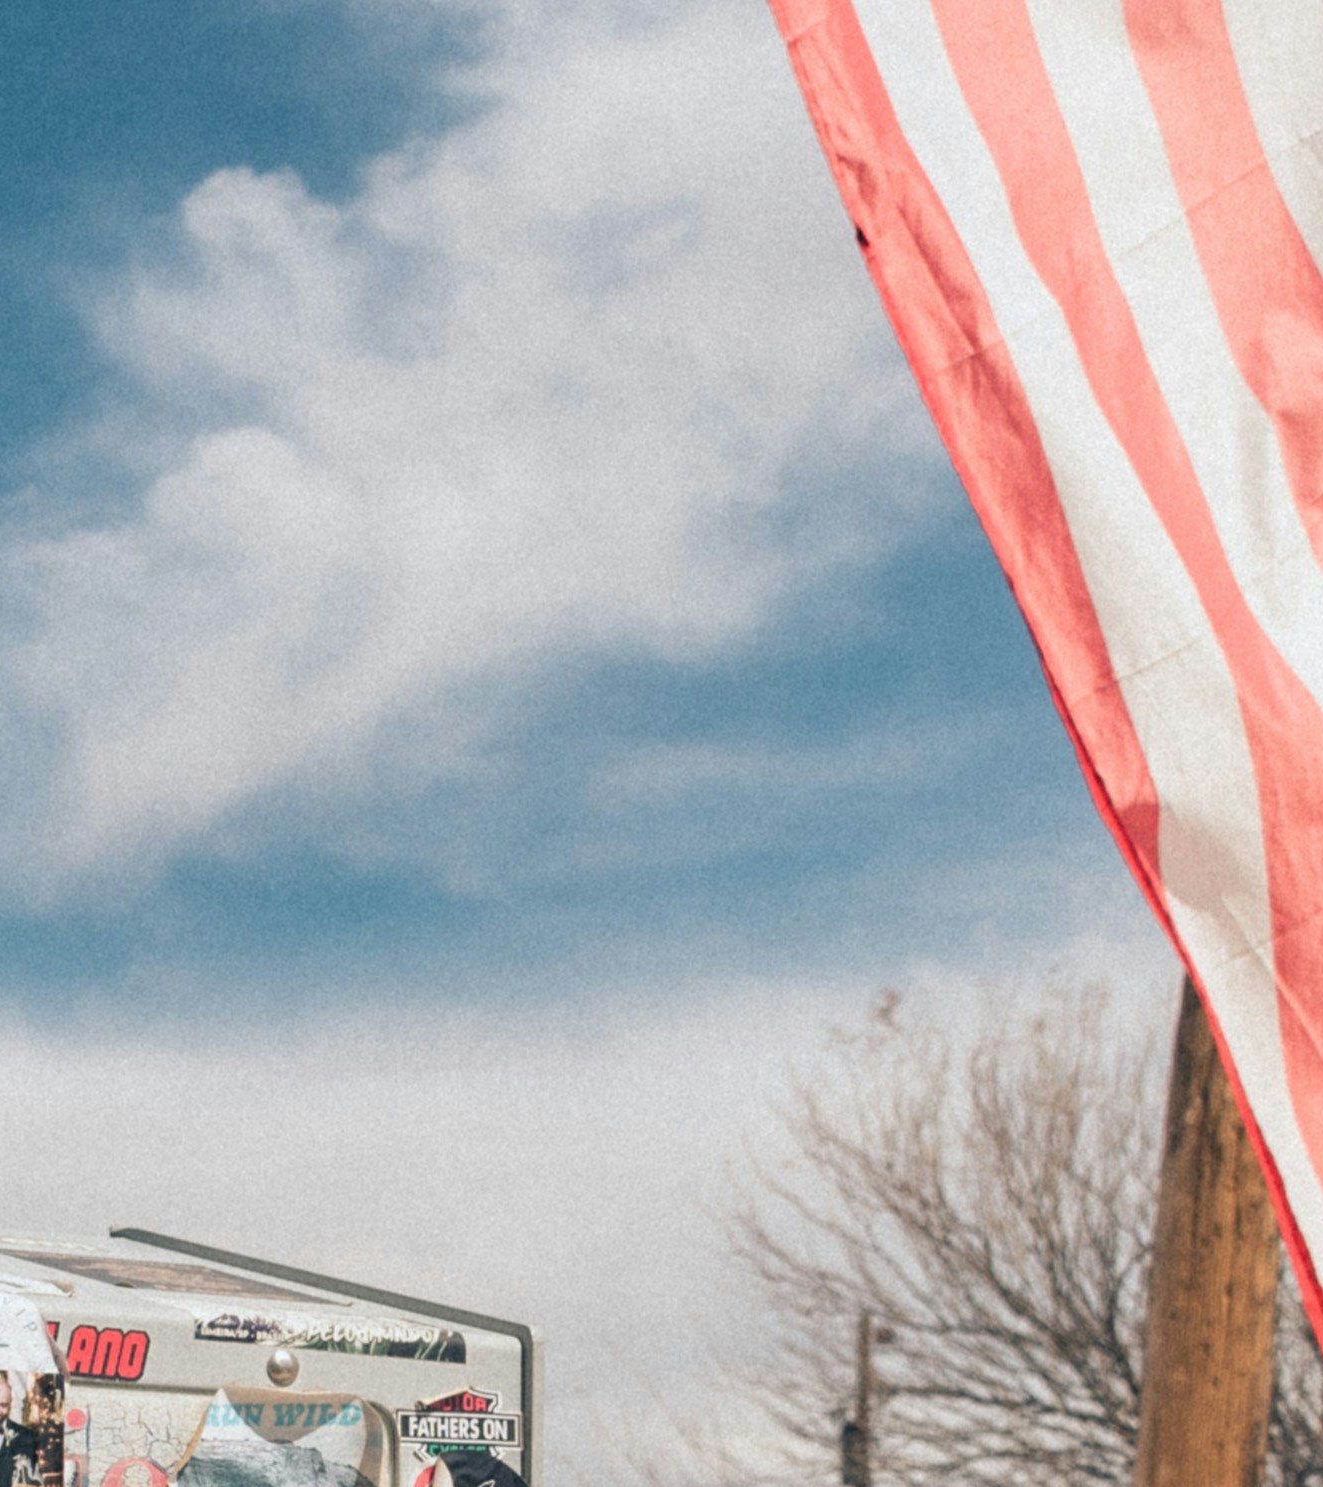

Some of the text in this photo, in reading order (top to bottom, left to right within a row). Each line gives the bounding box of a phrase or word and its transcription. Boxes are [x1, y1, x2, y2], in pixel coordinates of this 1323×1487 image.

[271, 1404, 362, 1428] WILD
[408, 1414, 509, 1440] FATHERS ON
